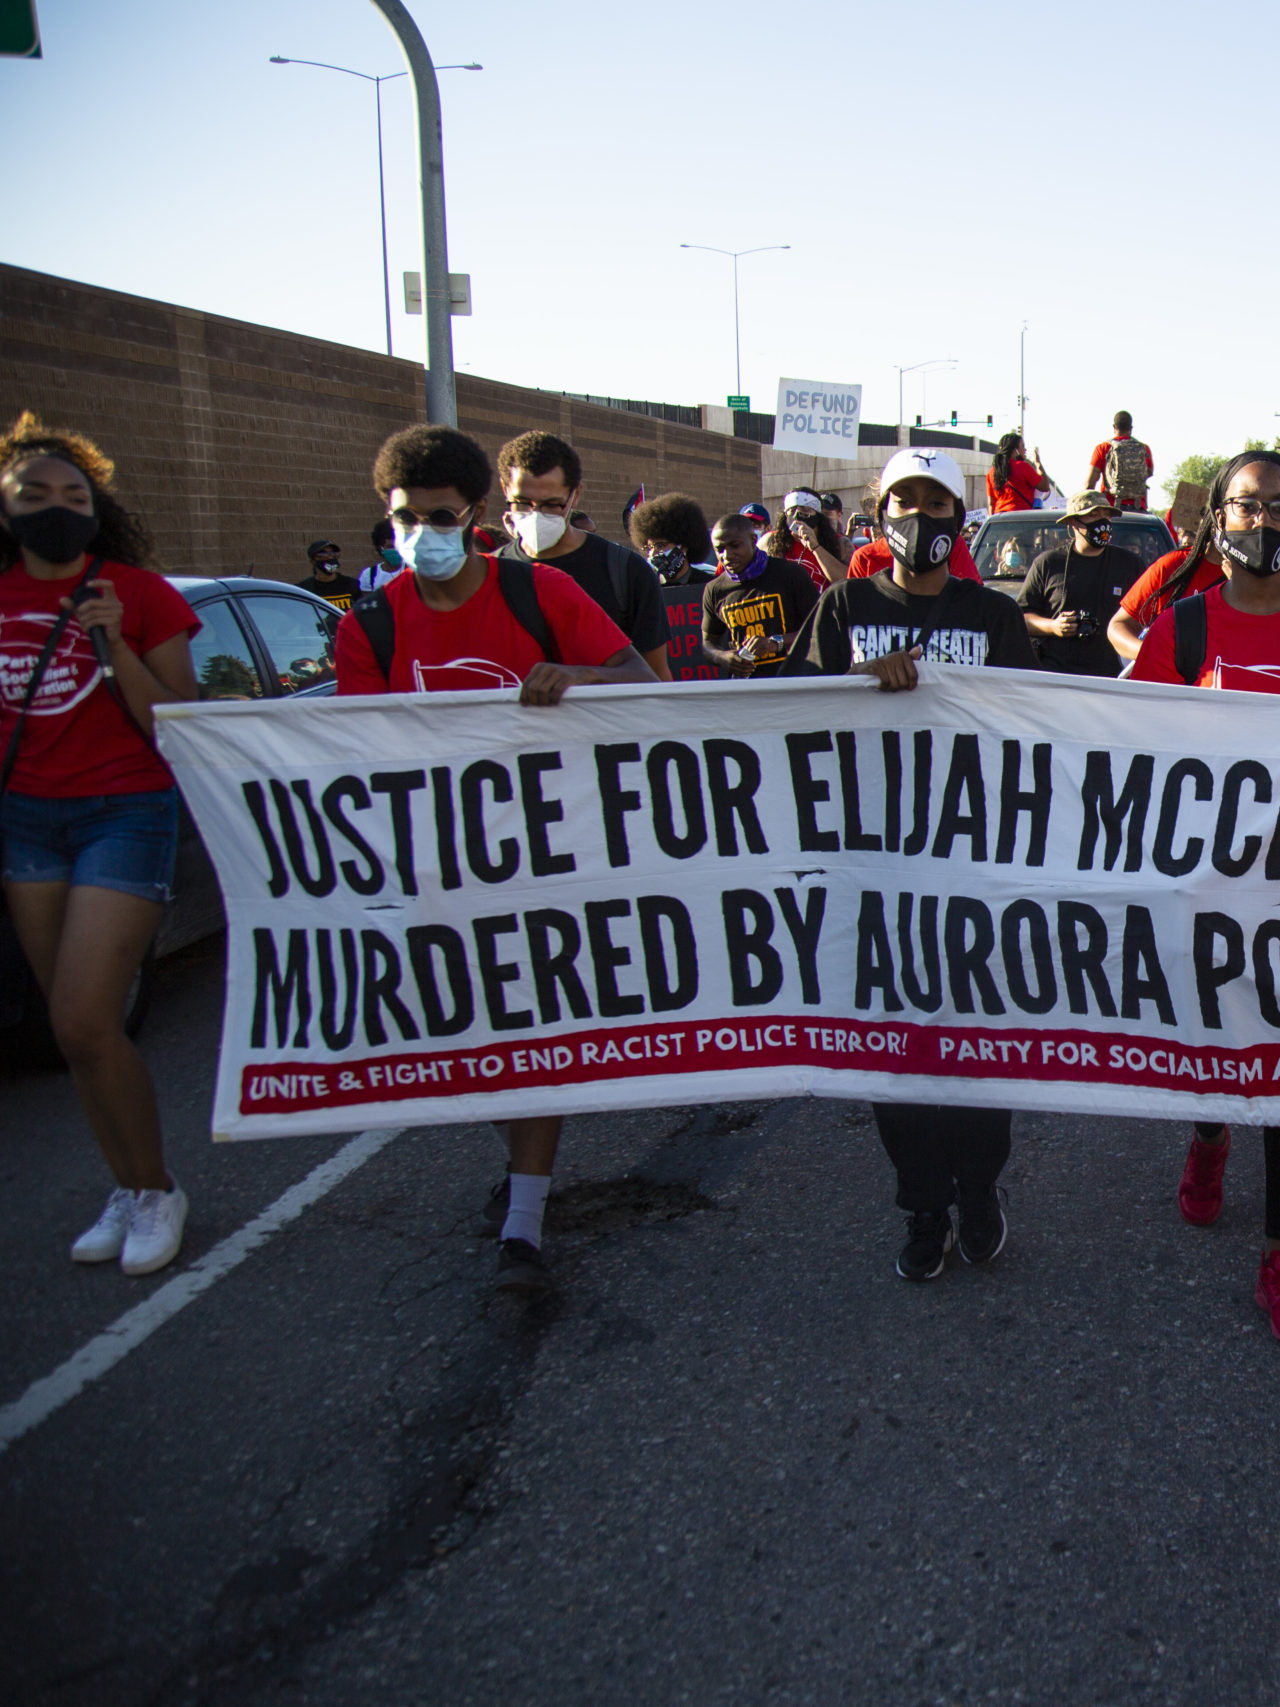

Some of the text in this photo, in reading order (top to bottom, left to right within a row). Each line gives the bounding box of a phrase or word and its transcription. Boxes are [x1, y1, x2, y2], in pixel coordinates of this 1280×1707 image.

[781, 413, 854, 438] POLICE
[785, 389, 858, 416] DEFUND
[727, 600, 775, 628] EQUITY
[242, 750, 577, 898] JUSTICE
[594, 738, 770, 868] FOR
[784, 729, 1053, 867] ELIJAH
[249, 894, 700, 1051] MURDERED
[721, 886, 828, 1007] BY
[854, 890, 1178, 1027] AURORA
[248, 1024, 908, 1100] UNITE & FIGHT TO END RACIST POLICE TERROR!
[939, 1035, 1034, 1065] PARTY
[1041, 1040, 1101, 1067] FOR
[1108, 1044, 1264, 1086] SOCIALISM
